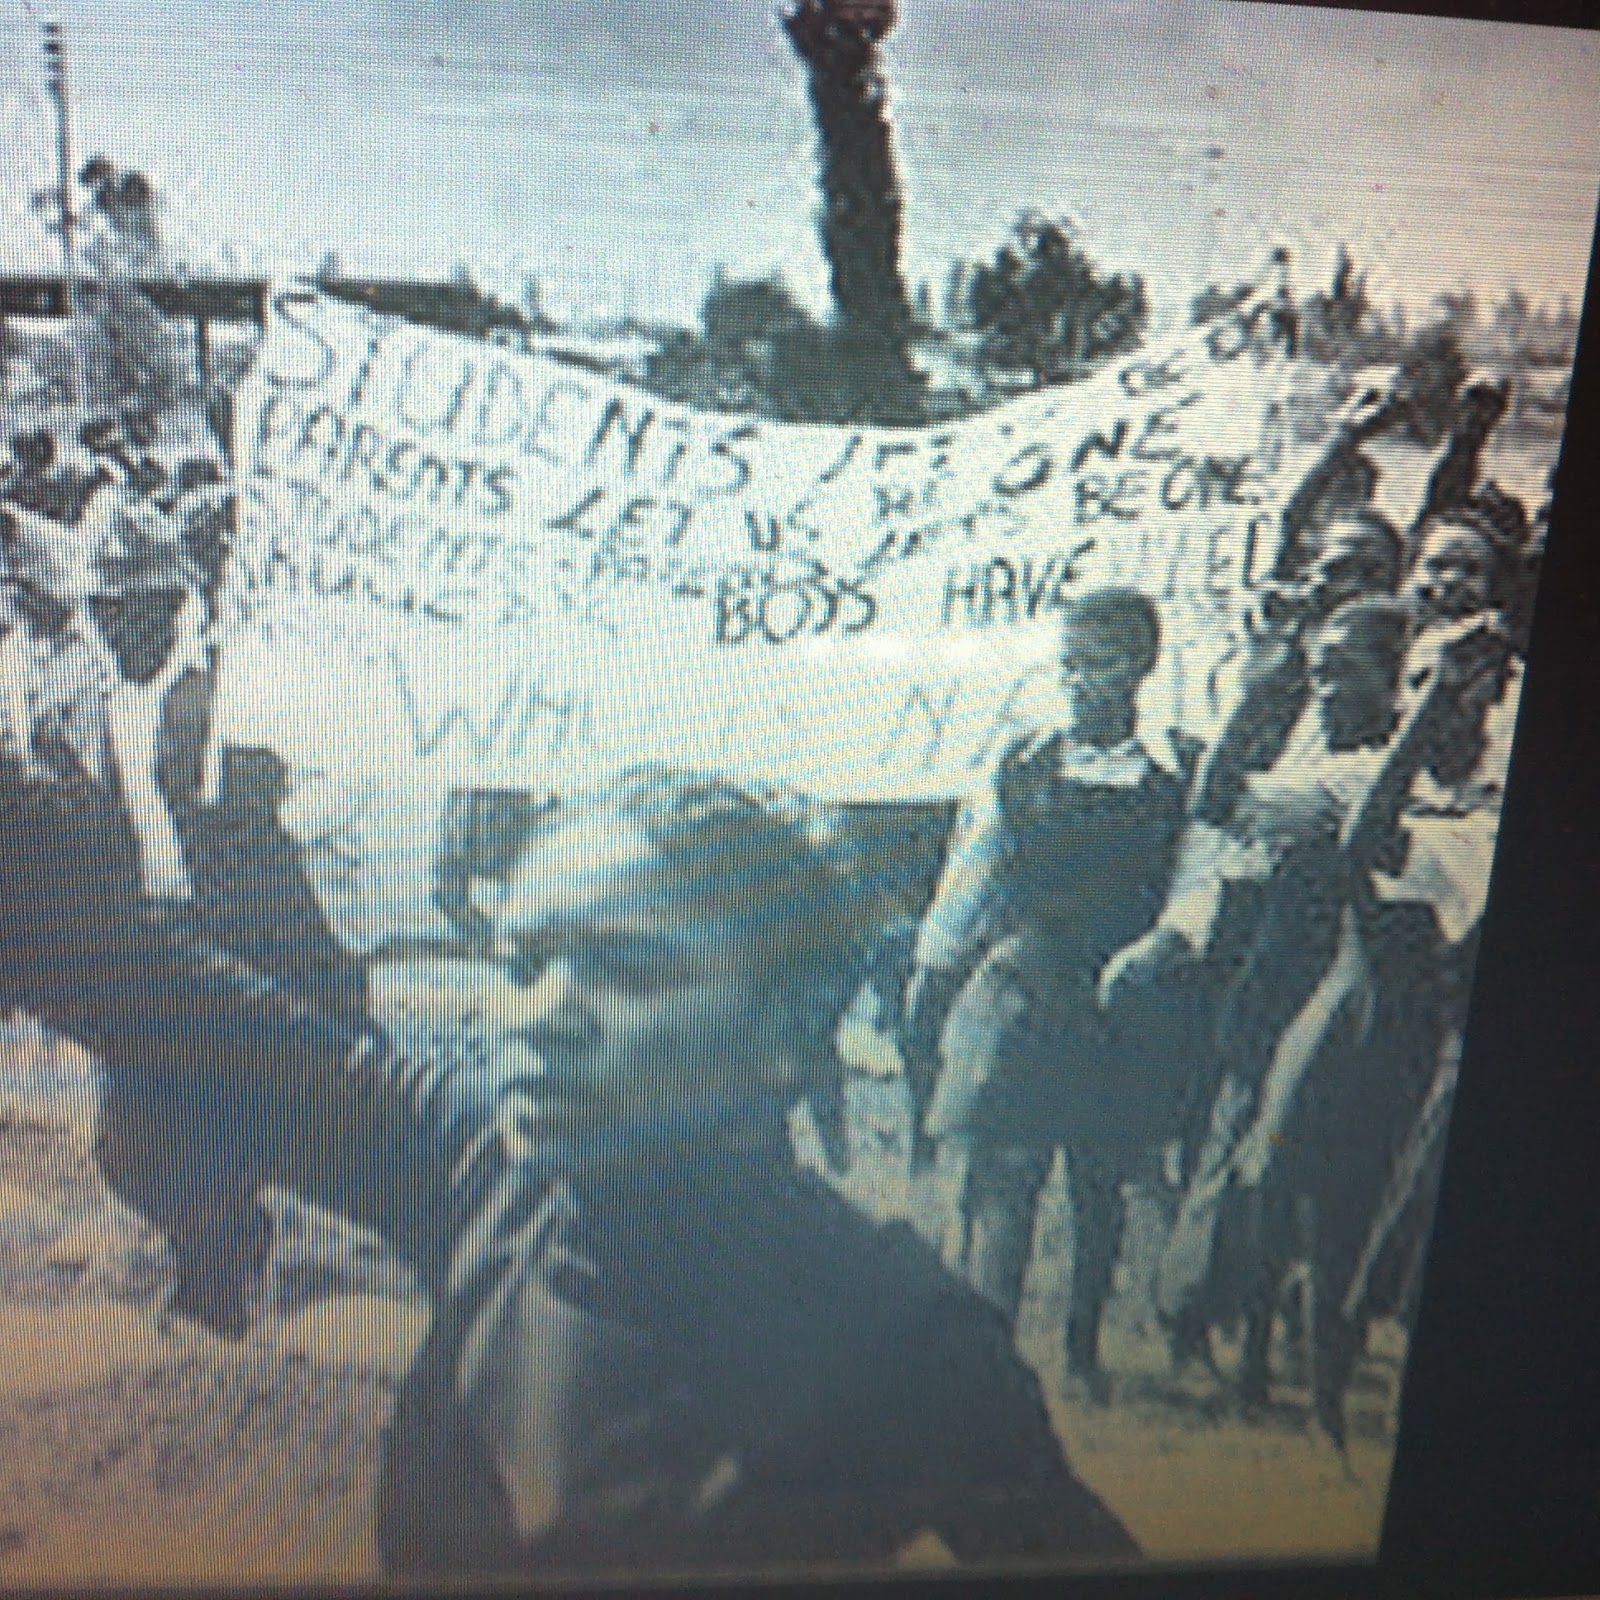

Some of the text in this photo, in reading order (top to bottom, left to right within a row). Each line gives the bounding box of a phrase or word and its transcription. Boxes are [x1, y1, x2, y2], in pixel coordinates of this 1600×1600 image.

[546, 490, 694, 549] LET
[992, 392, 1202, 494] ONE
[1073, 470, 1142, 524] BE
[940, 538, 1096, 625] HAVE
